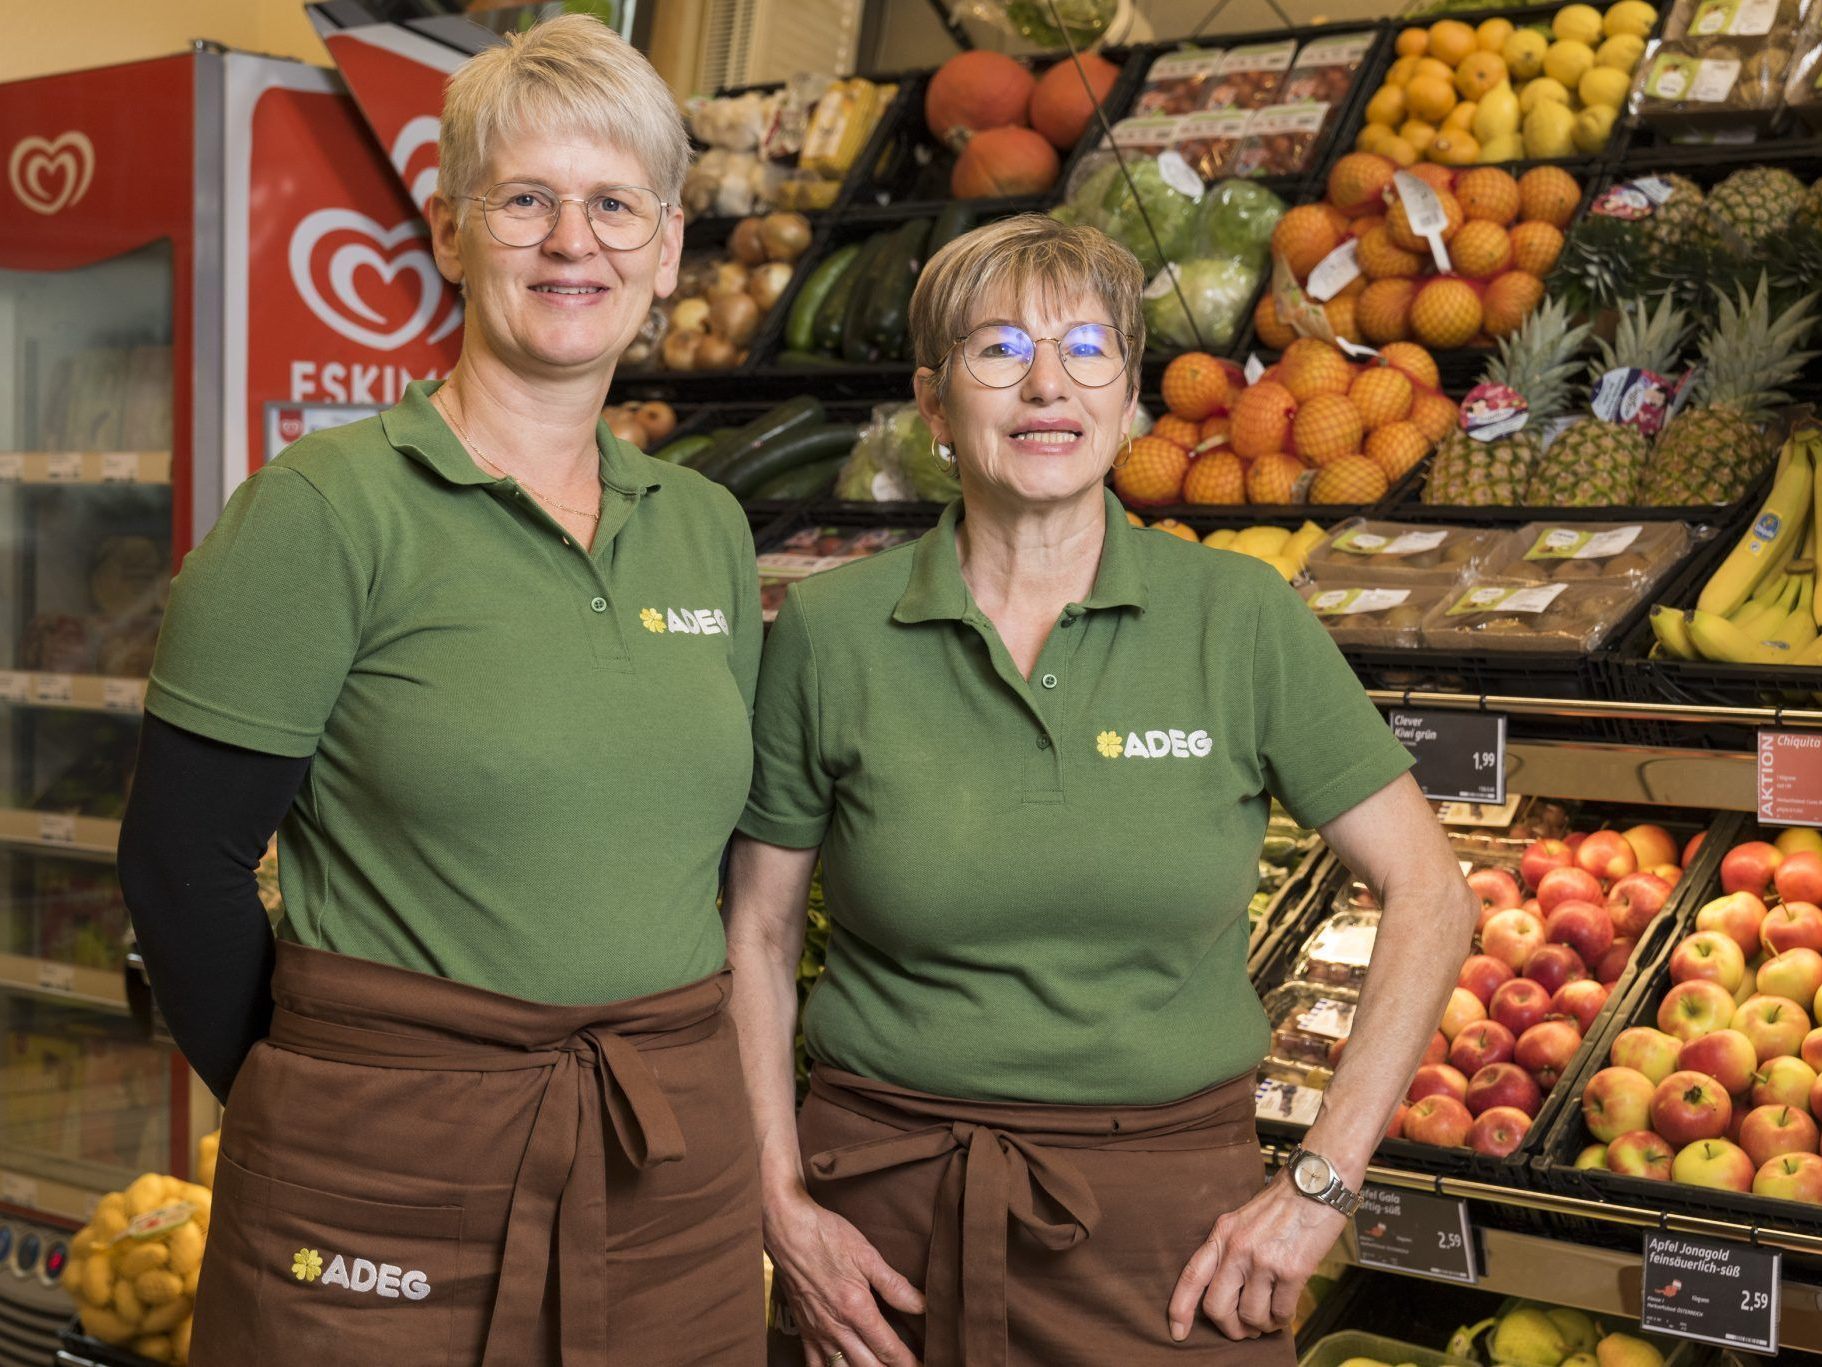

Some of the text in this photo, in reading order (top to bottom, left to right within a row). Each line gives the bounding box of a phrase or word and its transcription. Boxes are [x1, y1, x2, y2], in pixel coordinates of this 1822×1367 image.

[291, 361, 452, 404] ESKI
[1394, 715, 1423, 727] Clever
[1124, 729, 1213, 758] ADEG
[1394, 727, 1437, 742] Kiwi grün
[1761, 736, 1774, 817] AKTION
[1360, 1200, 1401, 1216] ftig-süß
[1378, 1191, 1400, 1204] Gala
[1649, 1238, 1730, 1261] Apfel Jonagold
[1649, 1252, 1741, 1277] feinsäuerlich-süß
[321, 1254, 431, 1300] ADEG
